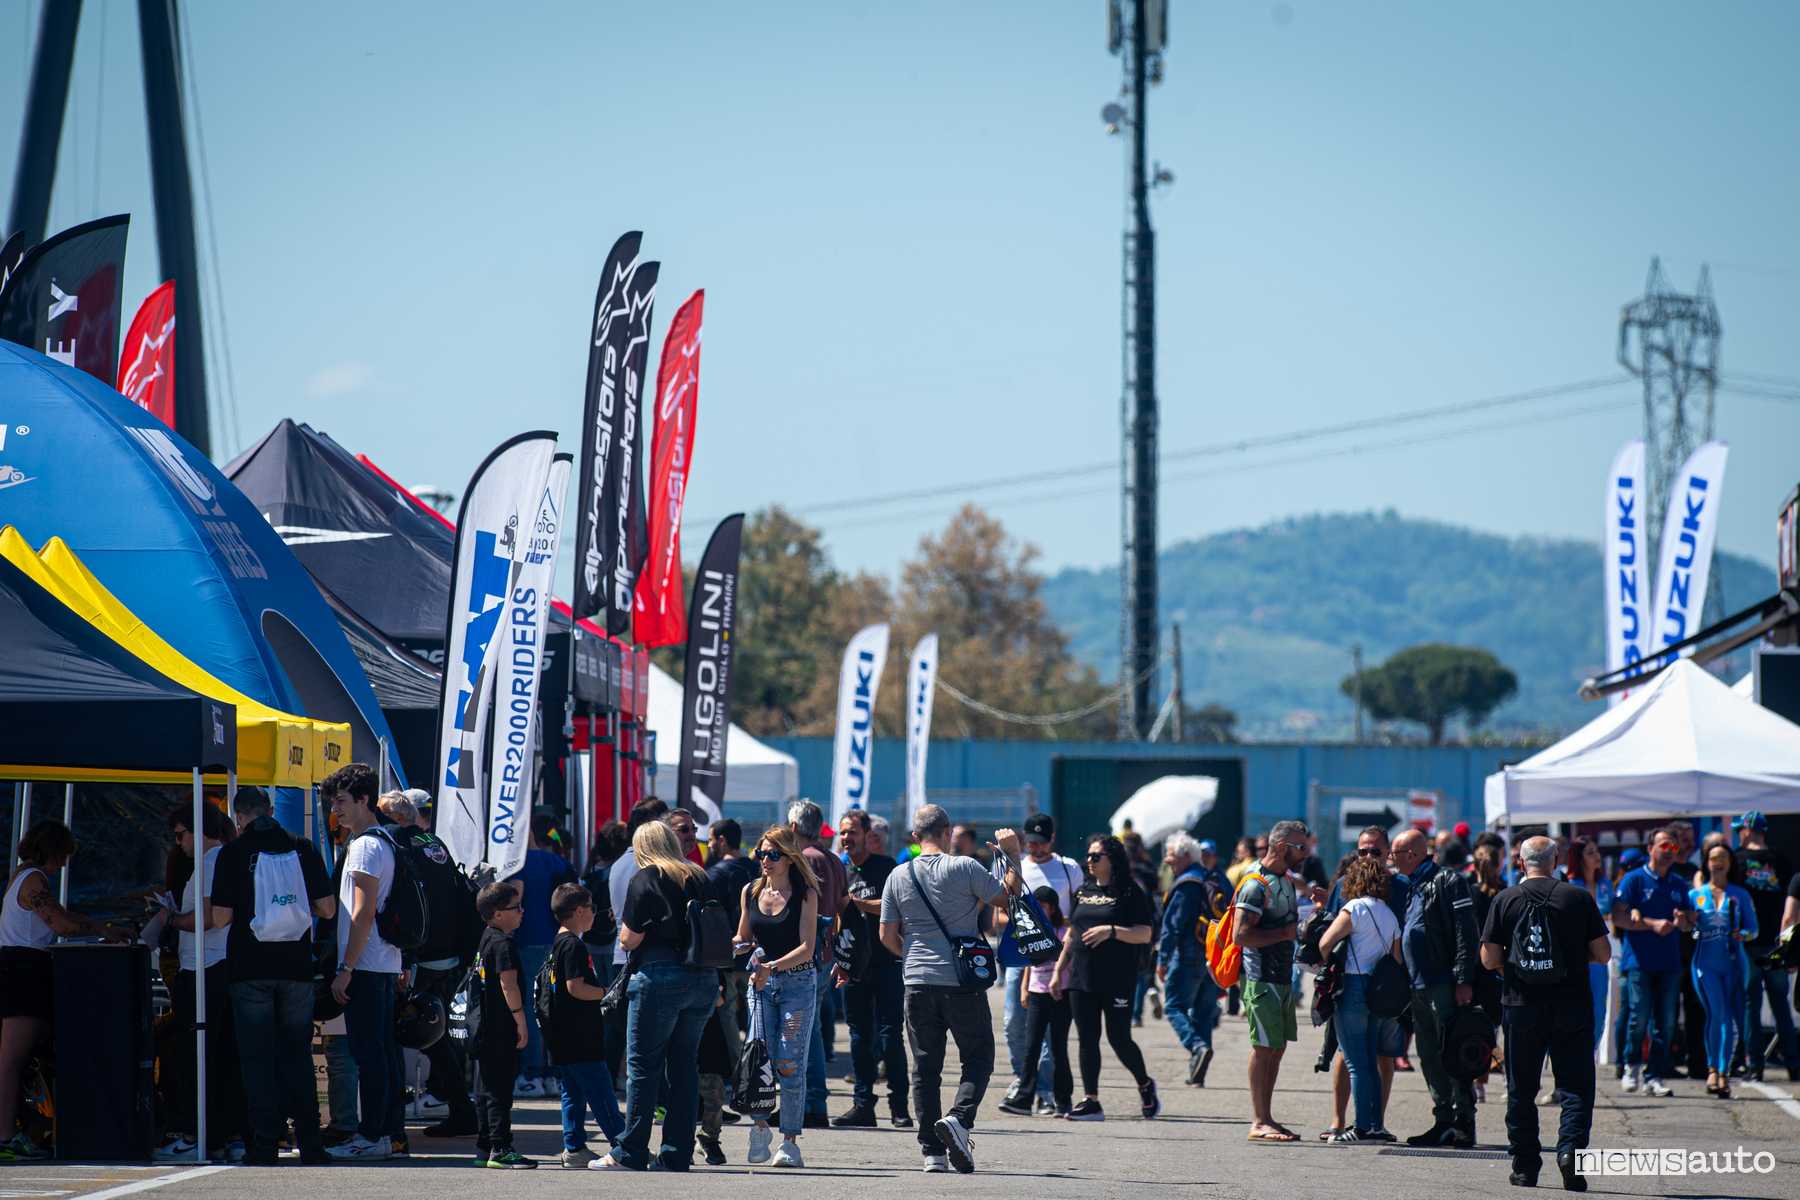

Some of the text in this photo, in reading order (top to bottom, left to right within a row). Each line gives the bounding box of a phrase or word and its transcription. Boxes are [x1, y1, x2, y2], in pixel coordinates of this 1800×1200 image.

[615, 365, 638, 612] alpinestars
[1664, 476, 1708, 665] UZUKI
[491, 587, 537, 844] OVER2000RIDERS
[693, 569, 723, 759] UGOLINI
[1529, 959, 1554, 970] POWER
